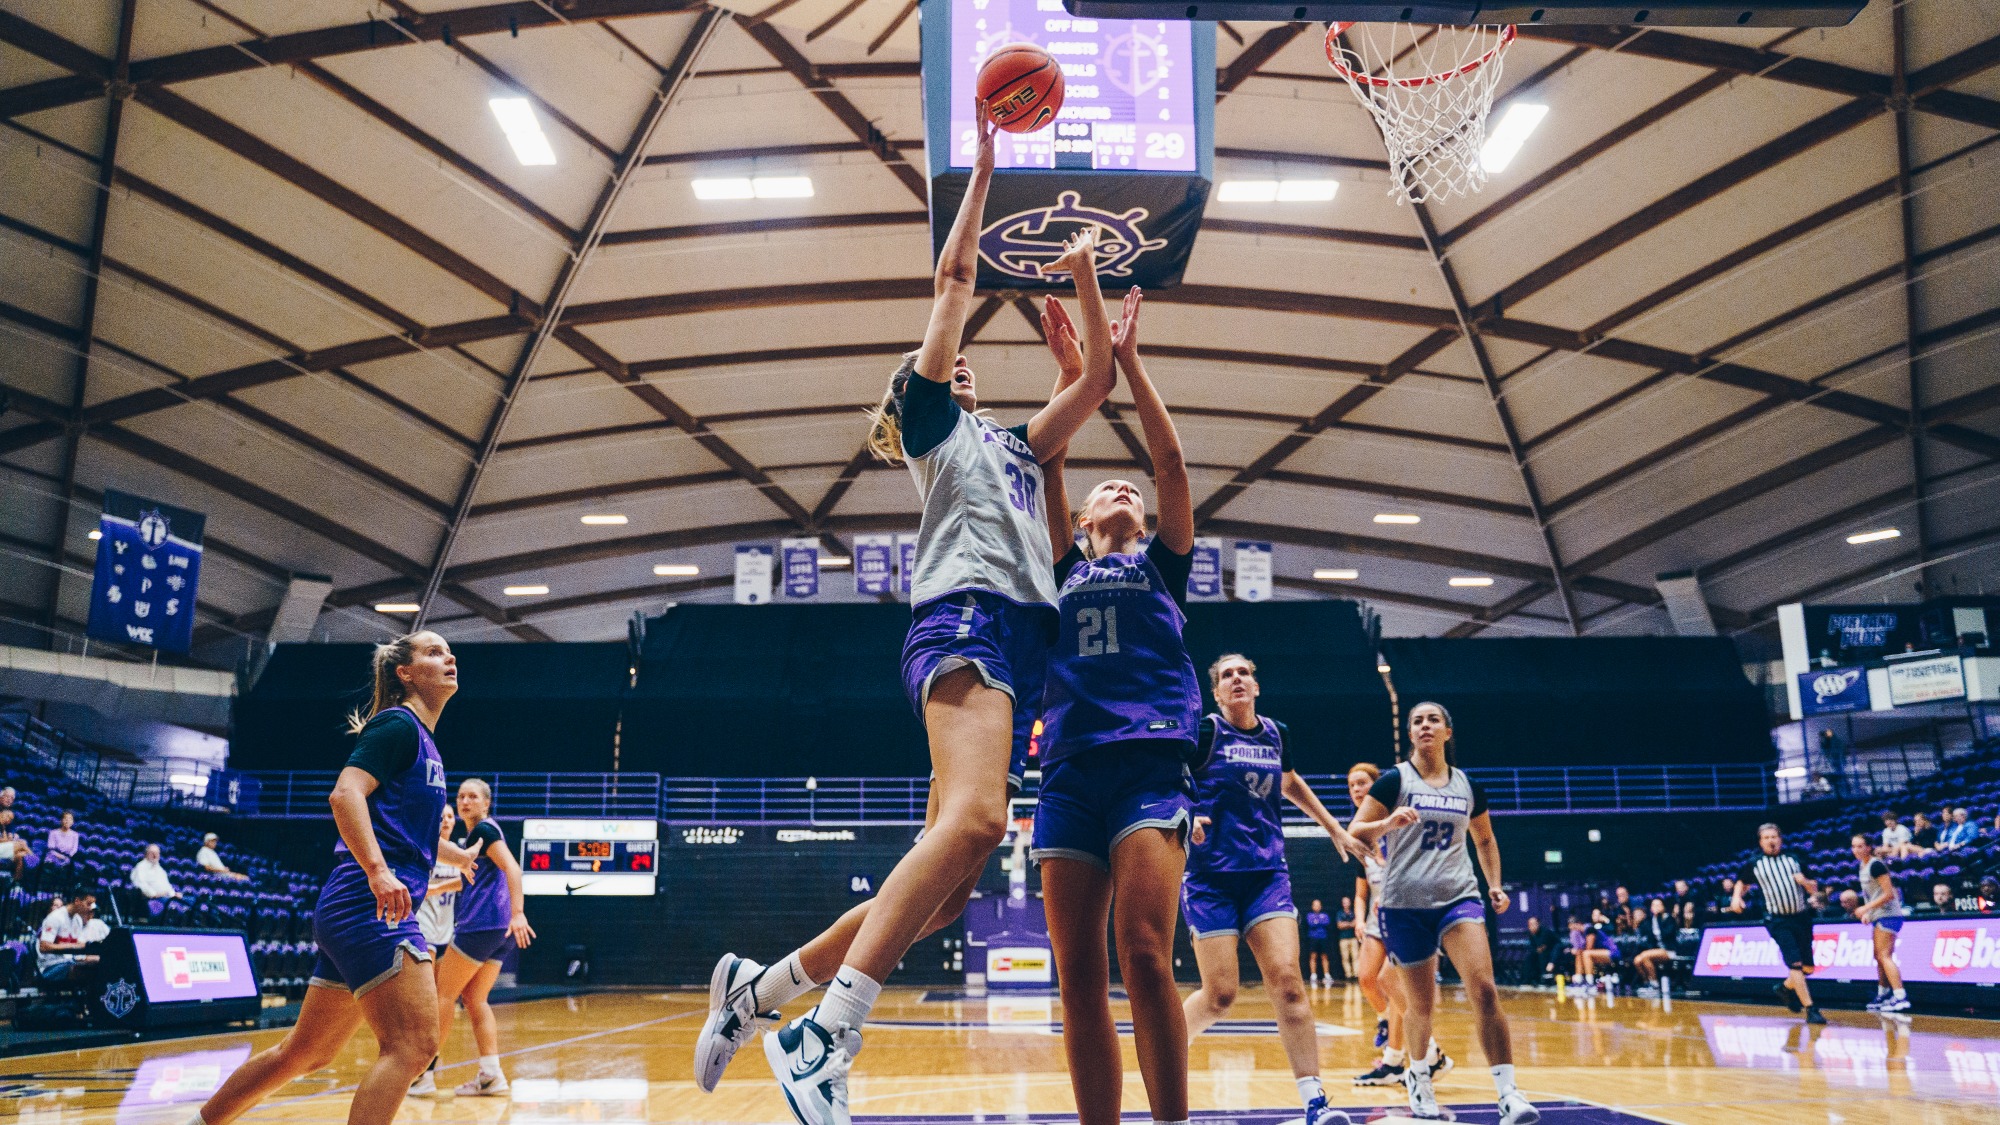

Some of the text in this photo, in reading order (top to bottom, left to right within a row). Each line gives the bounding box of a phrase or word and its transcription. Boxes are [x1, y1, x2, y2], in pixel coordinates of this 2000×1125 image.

[1045, 20, 1070, 32] OFF
[1145, 132, 1185, 159] 29
[1006, 462, 1037, 520] 30
[1076, 605, 1120, 657] 21
[1410, 795, 1467, 811] PORTLAND
[578, 841, 611, 857] 5:08
[1420, 820, 1454, 851] 23
